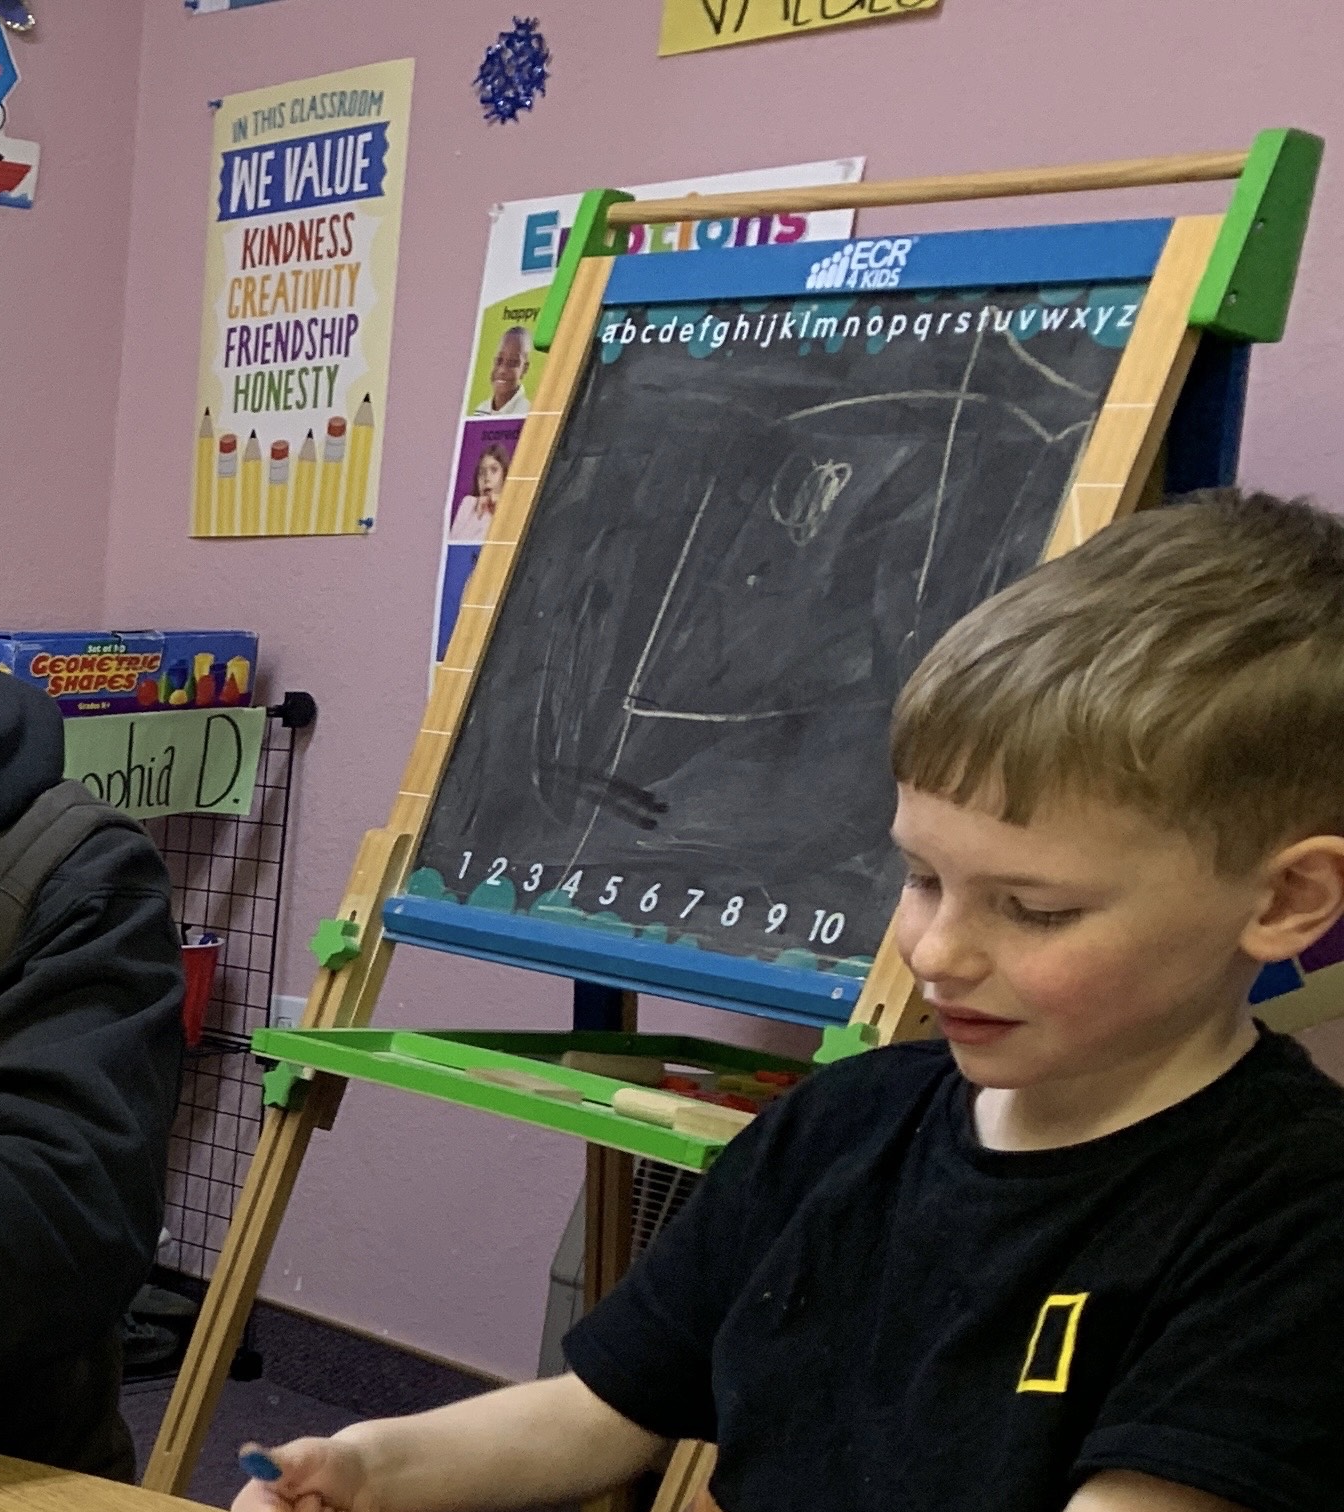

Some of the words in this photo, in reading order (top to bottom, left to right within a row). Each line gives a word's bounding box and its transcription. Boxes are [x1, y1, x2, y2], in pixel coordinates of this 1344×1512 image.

[231, 116, 248, 143] IN
[252, 103, 286, 136] THIS
[289, 90, 384, 125] CLASSROOM
[229, 150, 276, 213] WE
[284, 131, 373, 203] VALUE
[241, 212, 355, 270] KINDNESS
[850, 238, 912, 270] ECR
[227, 262, 361, 320] CREATIVITY
[861, 267, 901, 288] KIDS
[224, 313, 359, 369] FRIENDSHIP
[233, 363, 340, 414] HONESTY
[31, 653, 162, 677] GEOMETRIC
[48, 673, 137, 697] SHAPES
[457, 852, 473, 880] 1
[486, 856, 509, 886] 2
[522, 863, 545, 892] 3
[561, 869, 585, 899] 4
[598, 875, 625, 906] 5
[639, 882, 663, 913] 6
[679, 887, 705, 919] 7
[720, 895, 746, 928] 8
[764, 902, 789, 934] 9
[808, 909, 846, 945] 10
